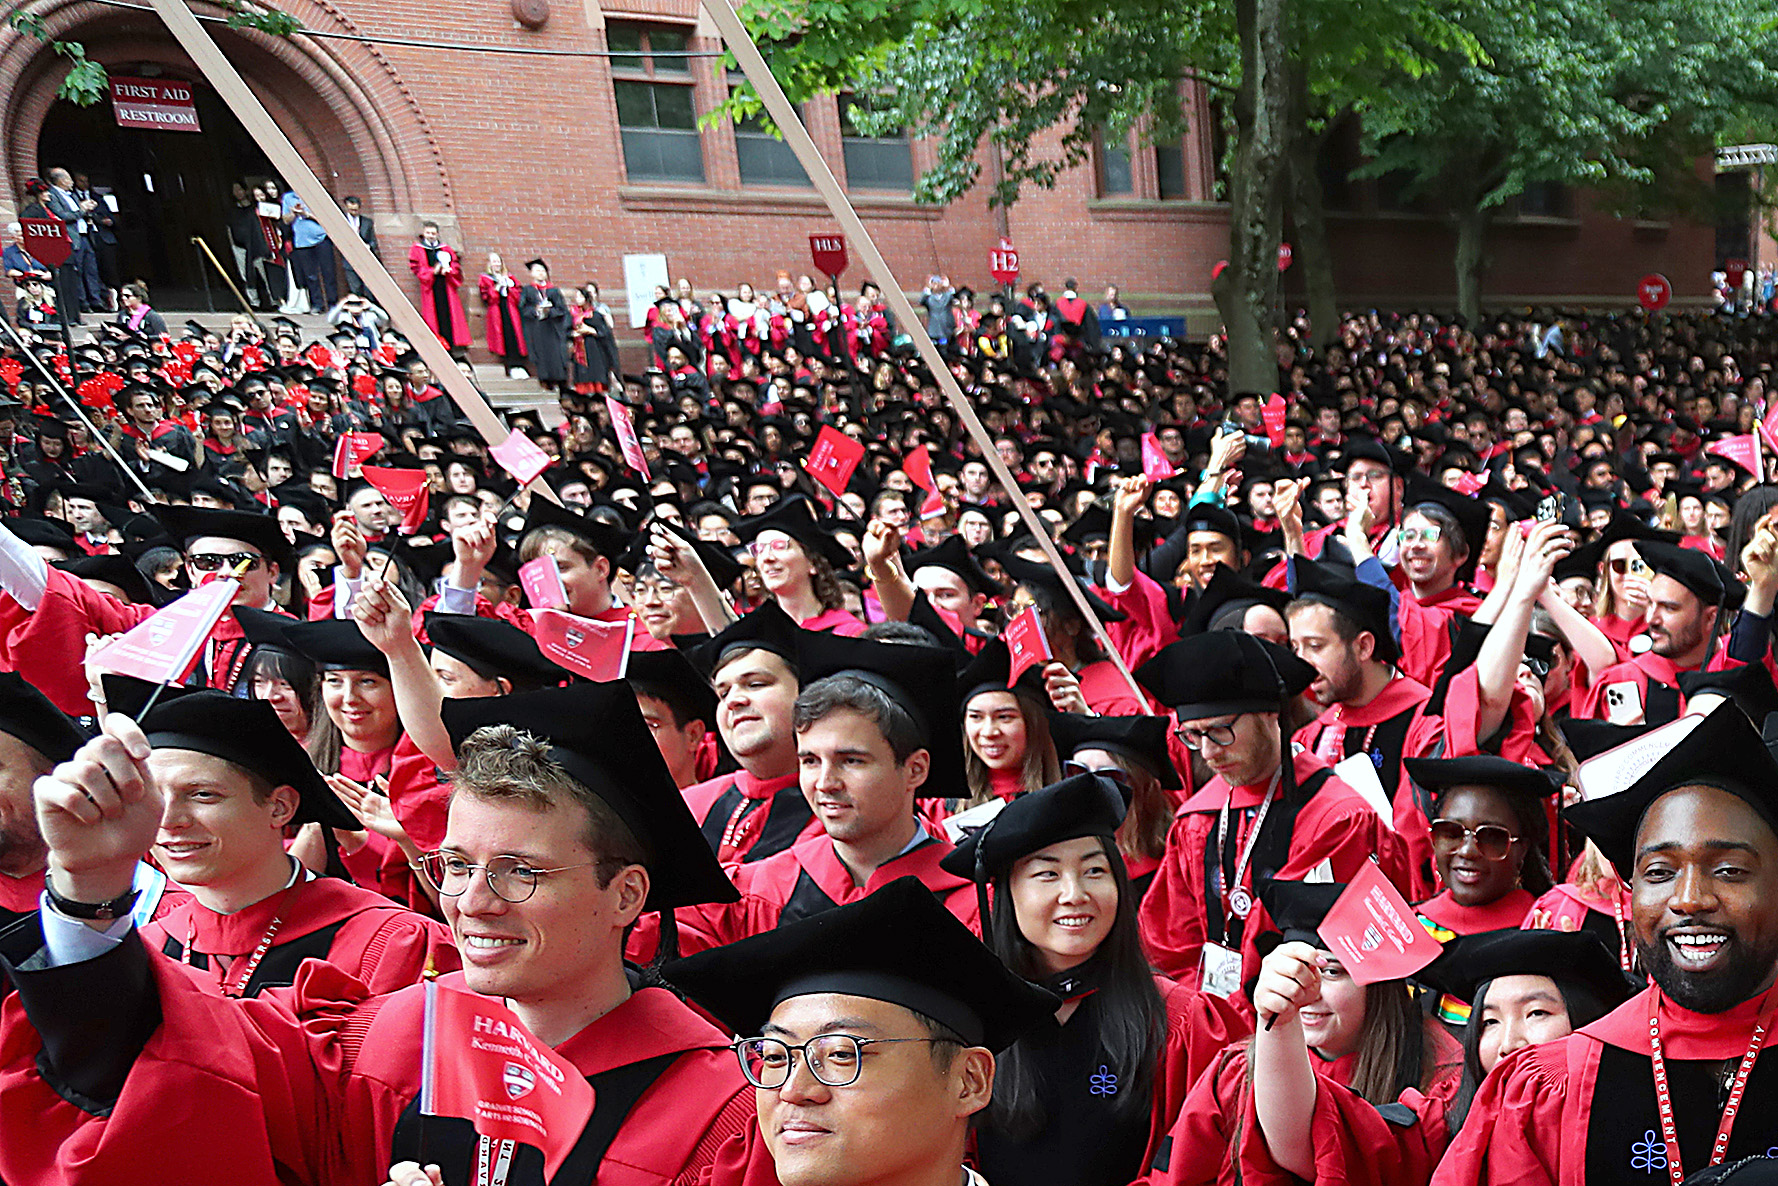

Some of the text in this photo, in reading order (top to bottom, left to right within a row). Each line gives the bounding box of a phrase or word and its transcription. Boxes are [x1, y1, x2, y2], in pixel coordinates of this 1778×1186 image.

[115, 84, 191, 101] FIRST AID
[120, 109, 196, 124] RESTROOM
[27, 223, 62, 238] SPH
[991, 250, 1018, 271] H2
[237, 917, 283, 991] UNIVERSITY
[471, 1036, 524, 1059] Kenneth
[473, 1015, 565, 1083] HARVARD
[1649, 1017, 1676, 1144] COMMENCEMENT
[1726, 1025, 1765, 1117] UNIVERSITY
